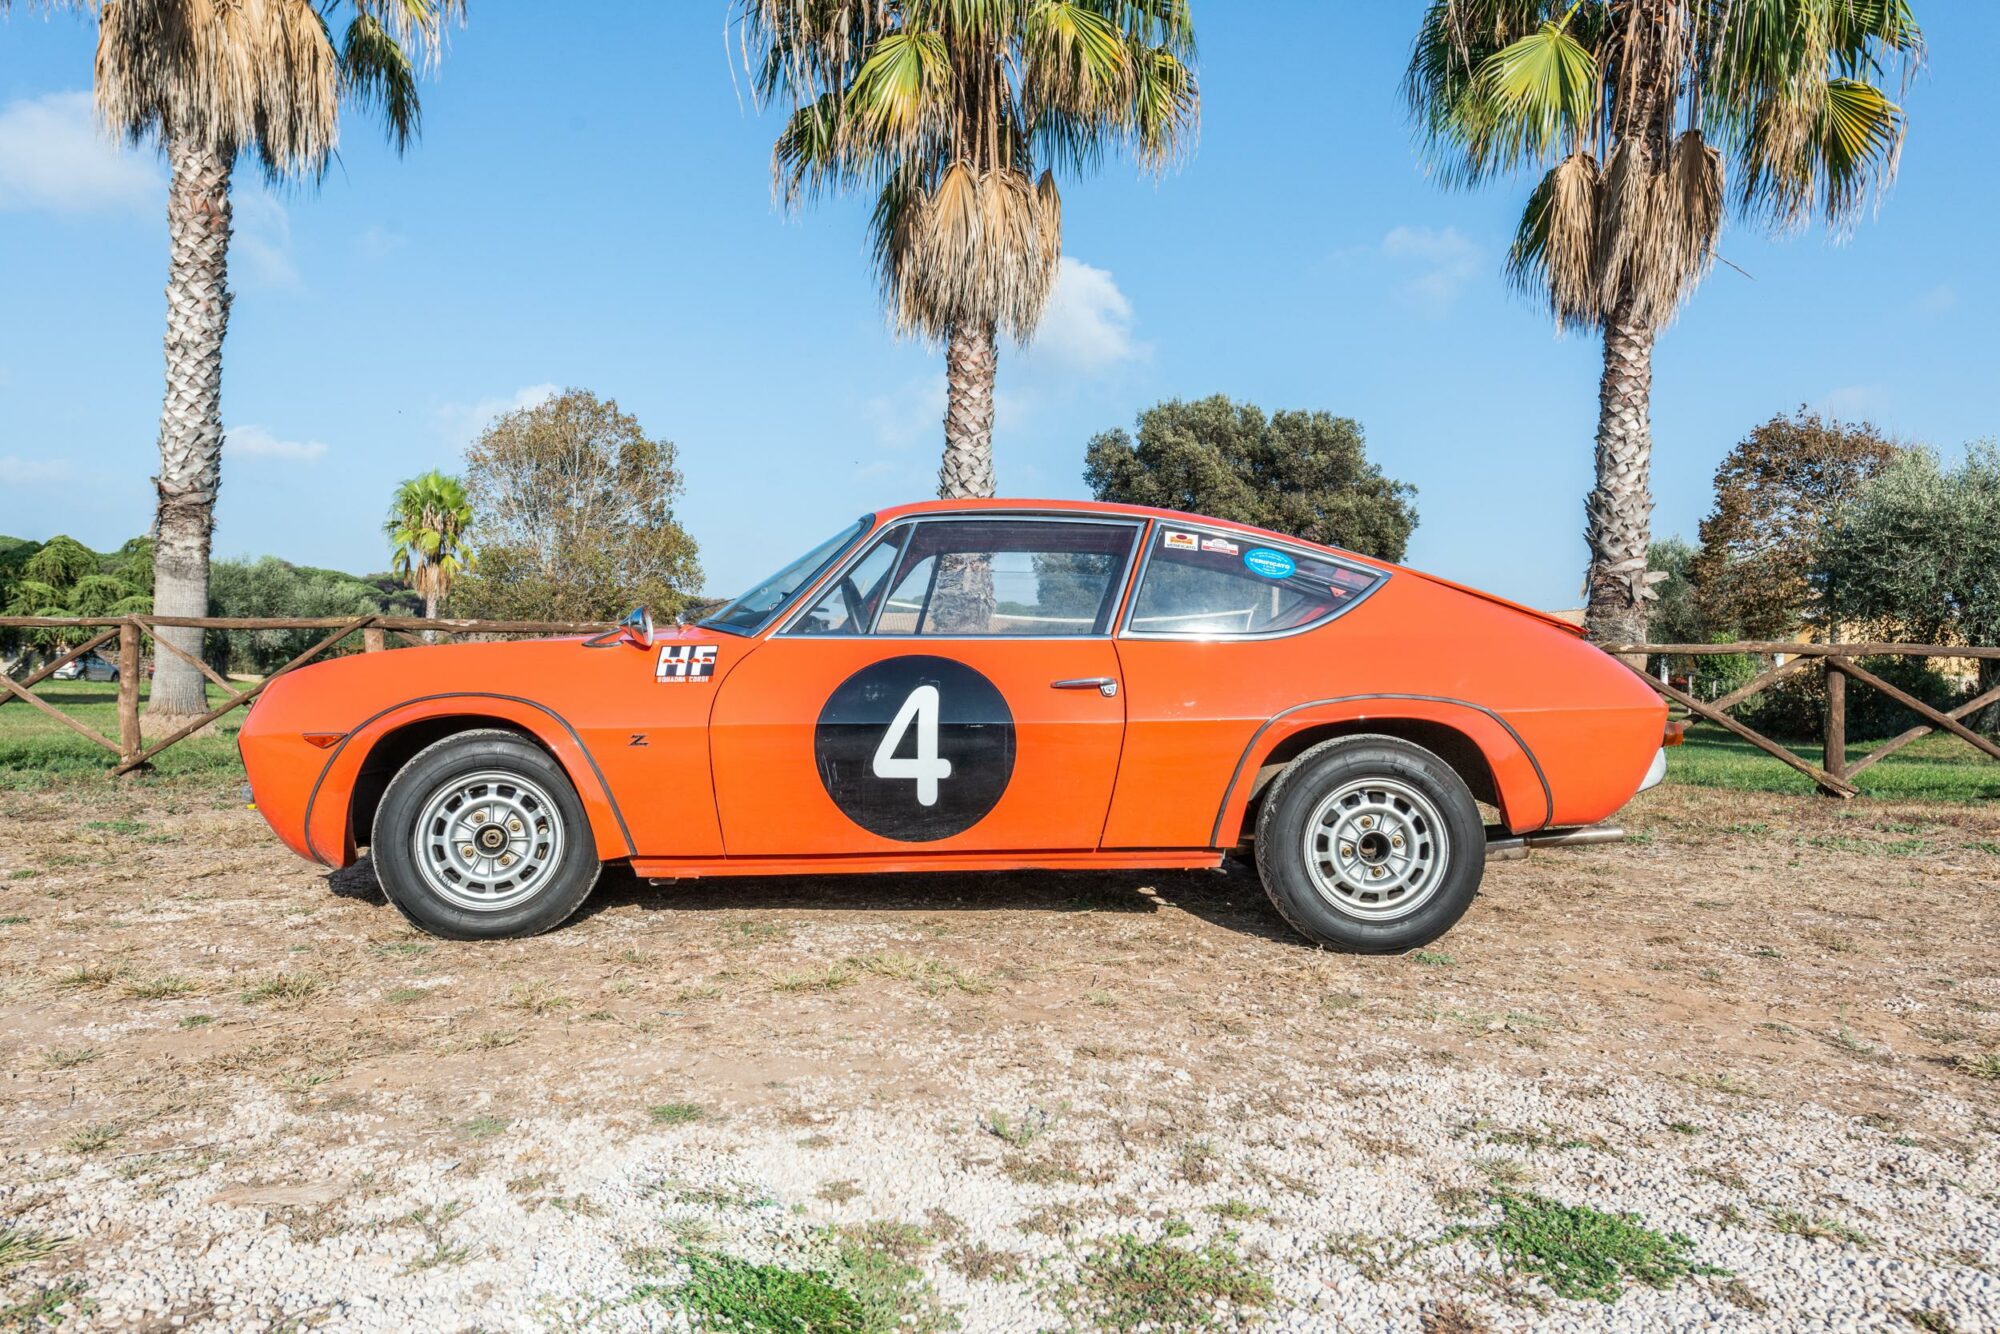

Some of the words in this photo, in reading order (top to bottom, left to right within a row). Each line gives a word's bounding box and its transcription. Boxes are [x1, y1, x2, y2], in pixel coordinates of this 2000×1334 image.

[1249, 557, 1290, 569] VERIFICATO
[656, 646, 717, 676] HF
[872, 685, 952, 806] 4
